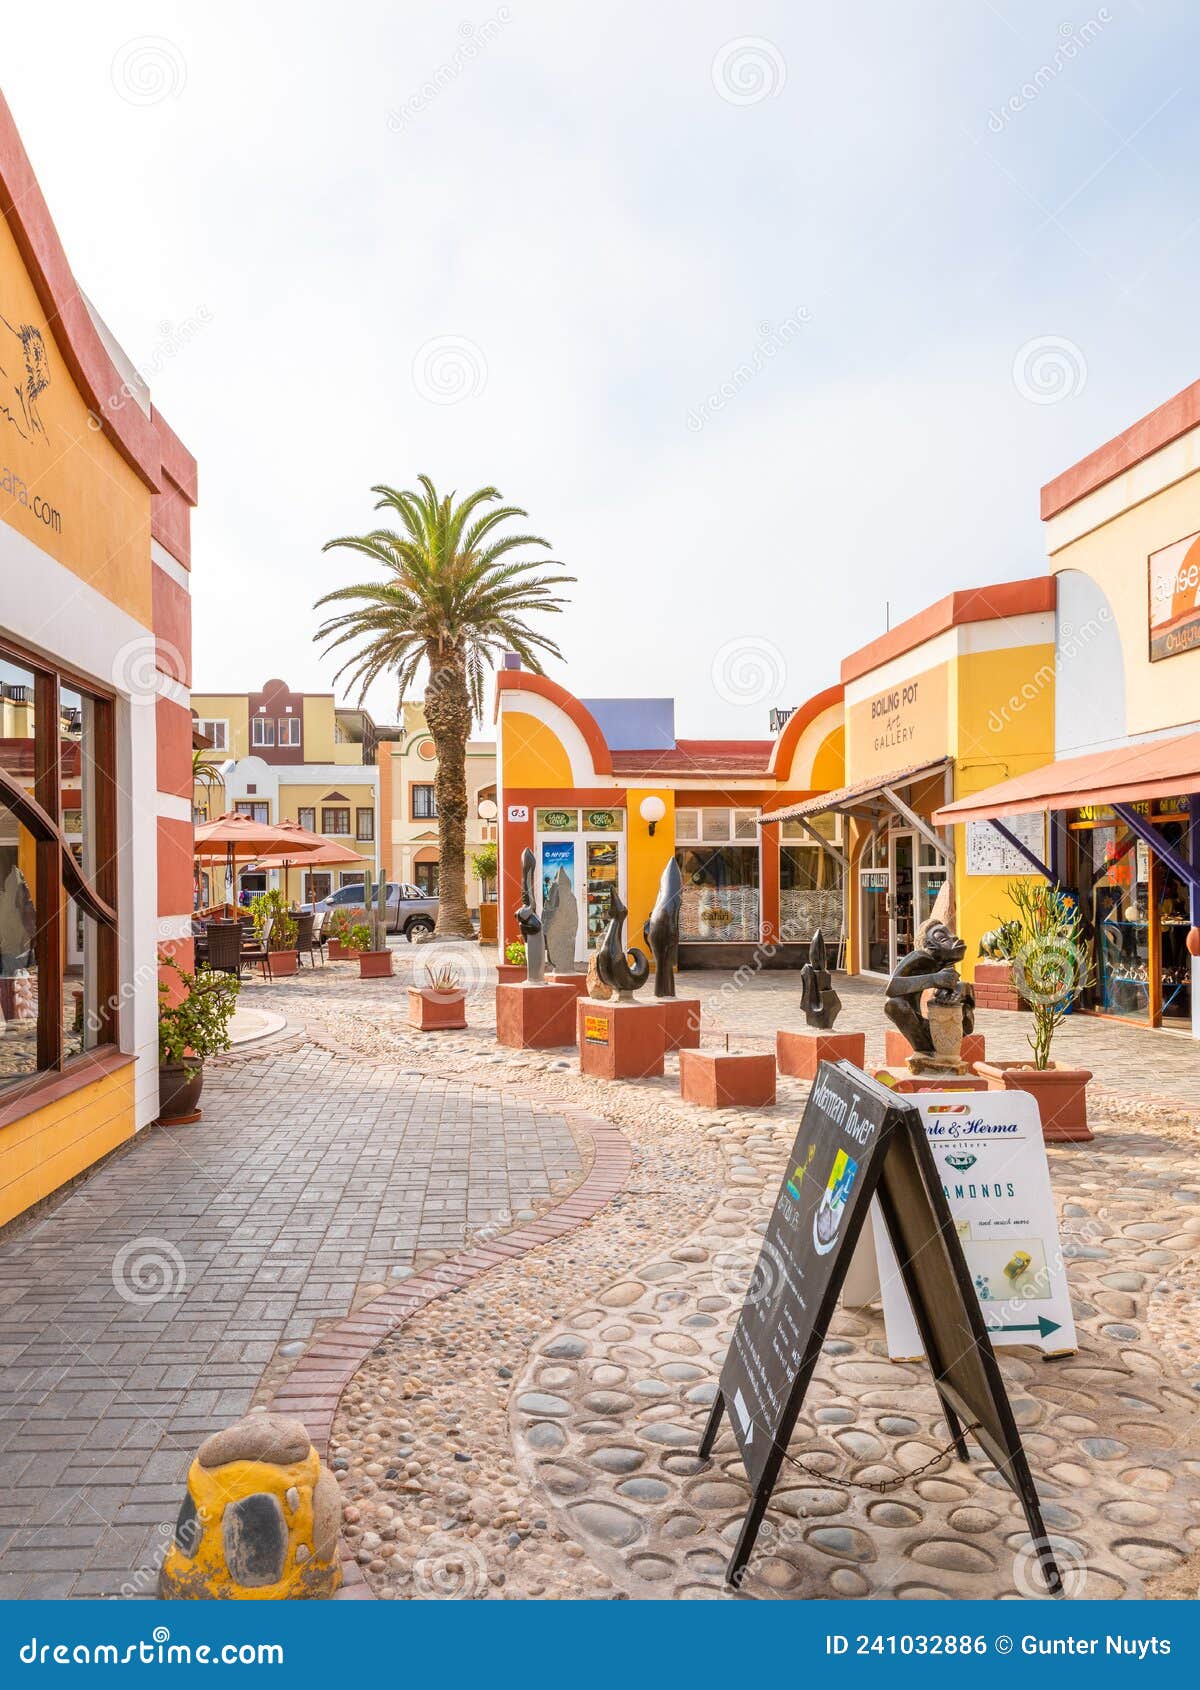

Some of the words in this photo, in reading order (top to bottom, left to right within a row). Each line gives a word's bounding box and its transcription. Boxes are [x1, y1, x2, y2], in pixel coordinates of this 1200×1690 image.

[0, 466, 62, 535] ara.com
[871, 691, 900, 720] BOILING
[902, 682, 919, 707] POT
[874, 725, 916, 752] GALLERY
[845, 1093, 876, 1146] Tower
[948, 1121, 960, 1138] &
[962, 1118, 1018, 1135] Herma
